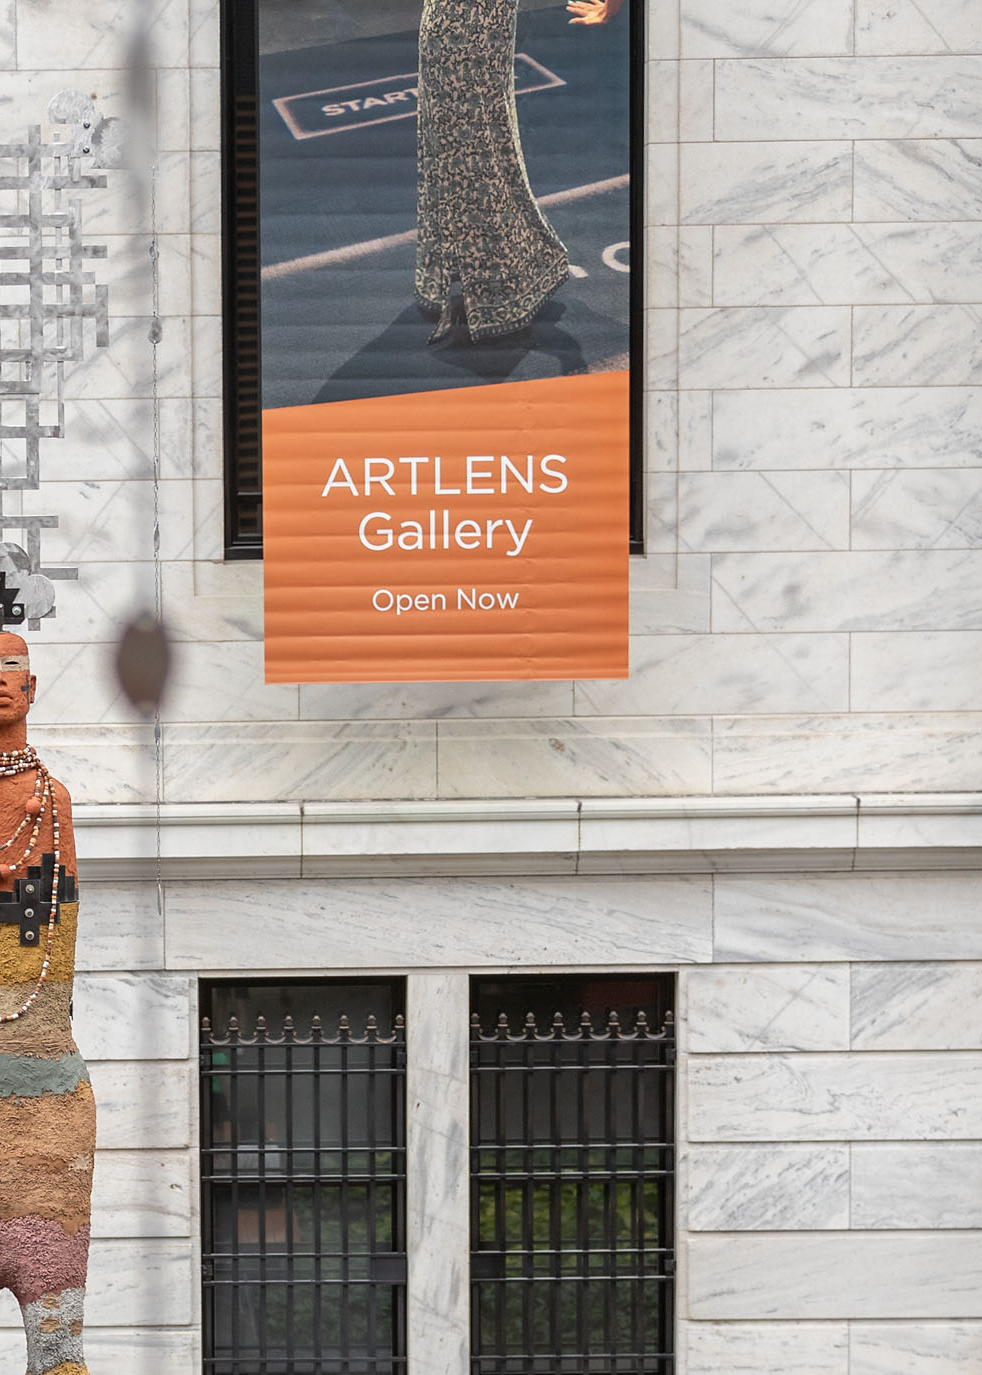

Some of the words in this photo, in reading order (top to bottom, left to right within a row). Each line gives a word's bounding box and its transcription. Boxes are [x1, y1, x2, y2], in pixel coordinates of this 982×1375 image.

[321, 454, 569, 497] ARTLENS
[358, 509, 533, 557] Gallery
[372, 588, 446, 616] Open
[457, 587, 520, 610] Now
